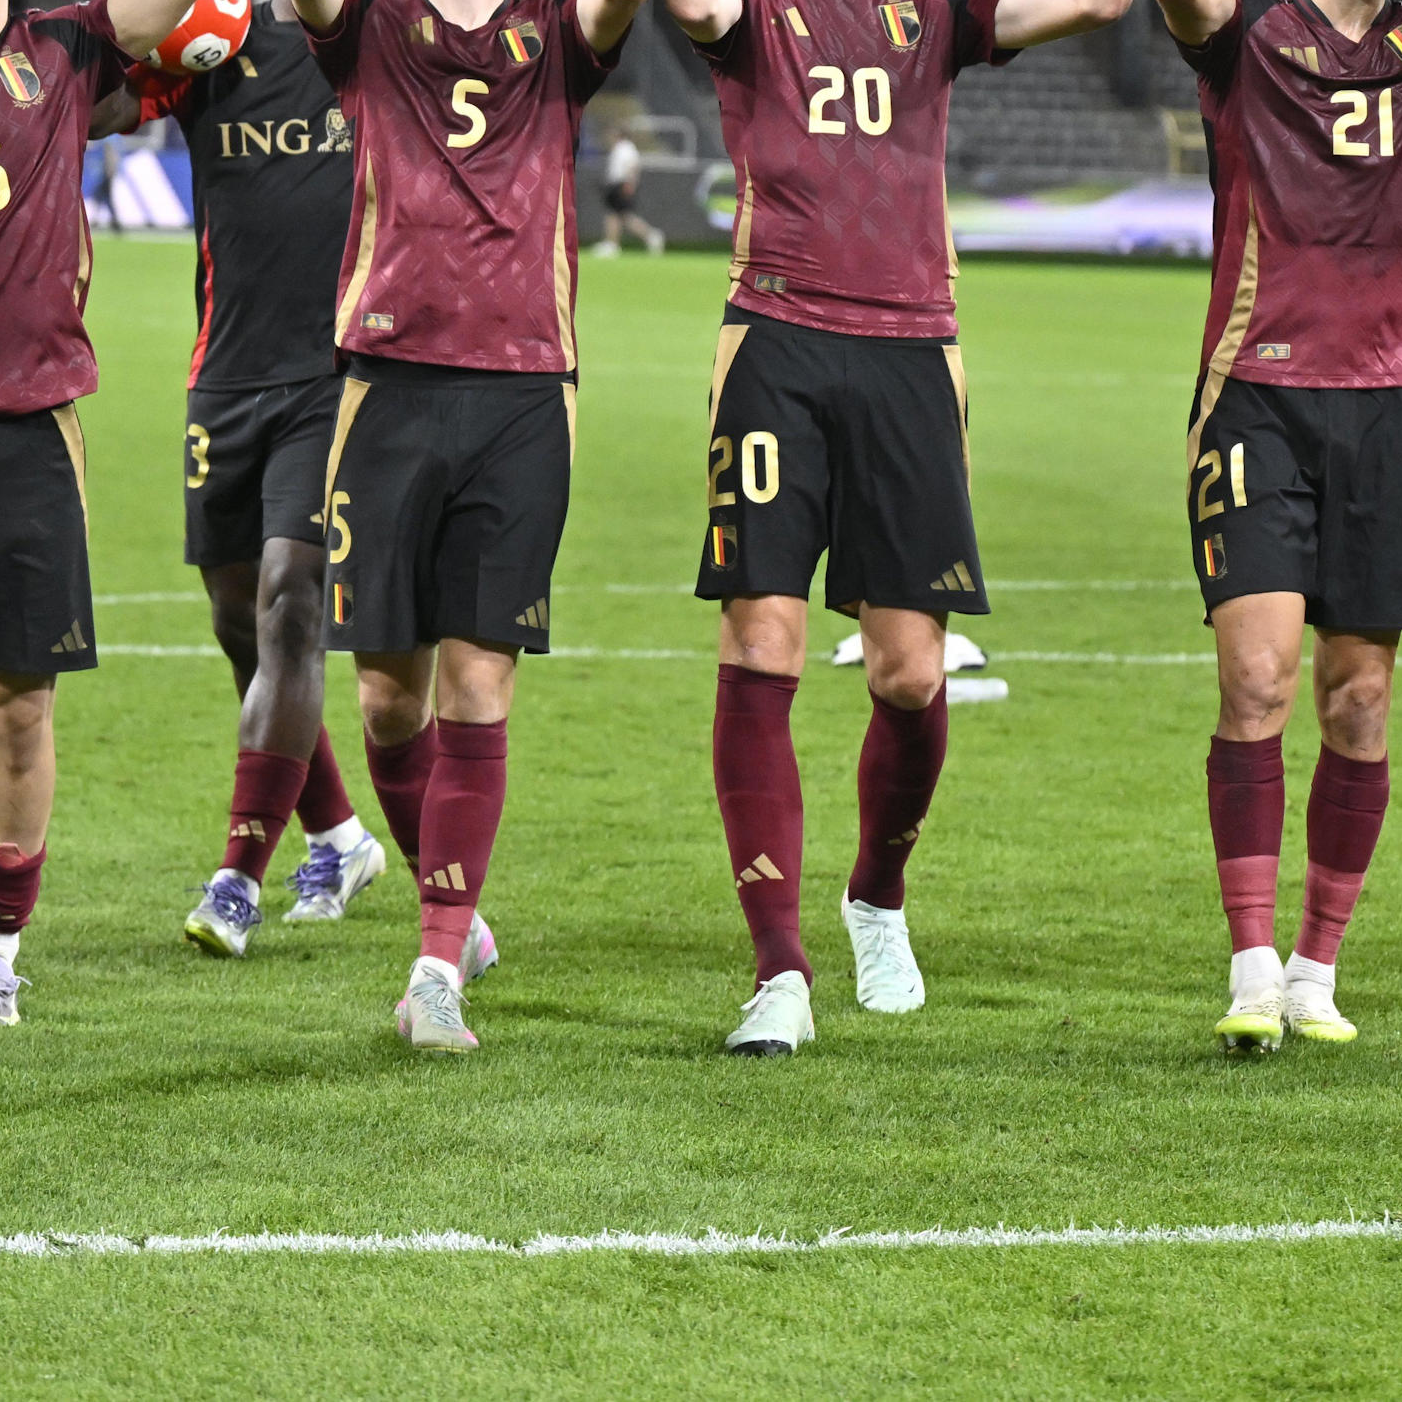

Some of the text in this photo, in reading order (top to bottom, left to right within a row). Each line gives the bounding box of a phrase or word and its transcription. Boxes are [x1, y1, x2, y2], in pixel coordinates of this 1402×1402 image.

[447, 79, 490, 148] 5
[808, 65, 892, 136] 20
[1331, 88, 1395, 157] 21
[217, 118, 312, 158] ING
[709, 431, 779, 505] 20
[1197, 442, 1245, 523] 21
[329, 490, 352, 564] 5
